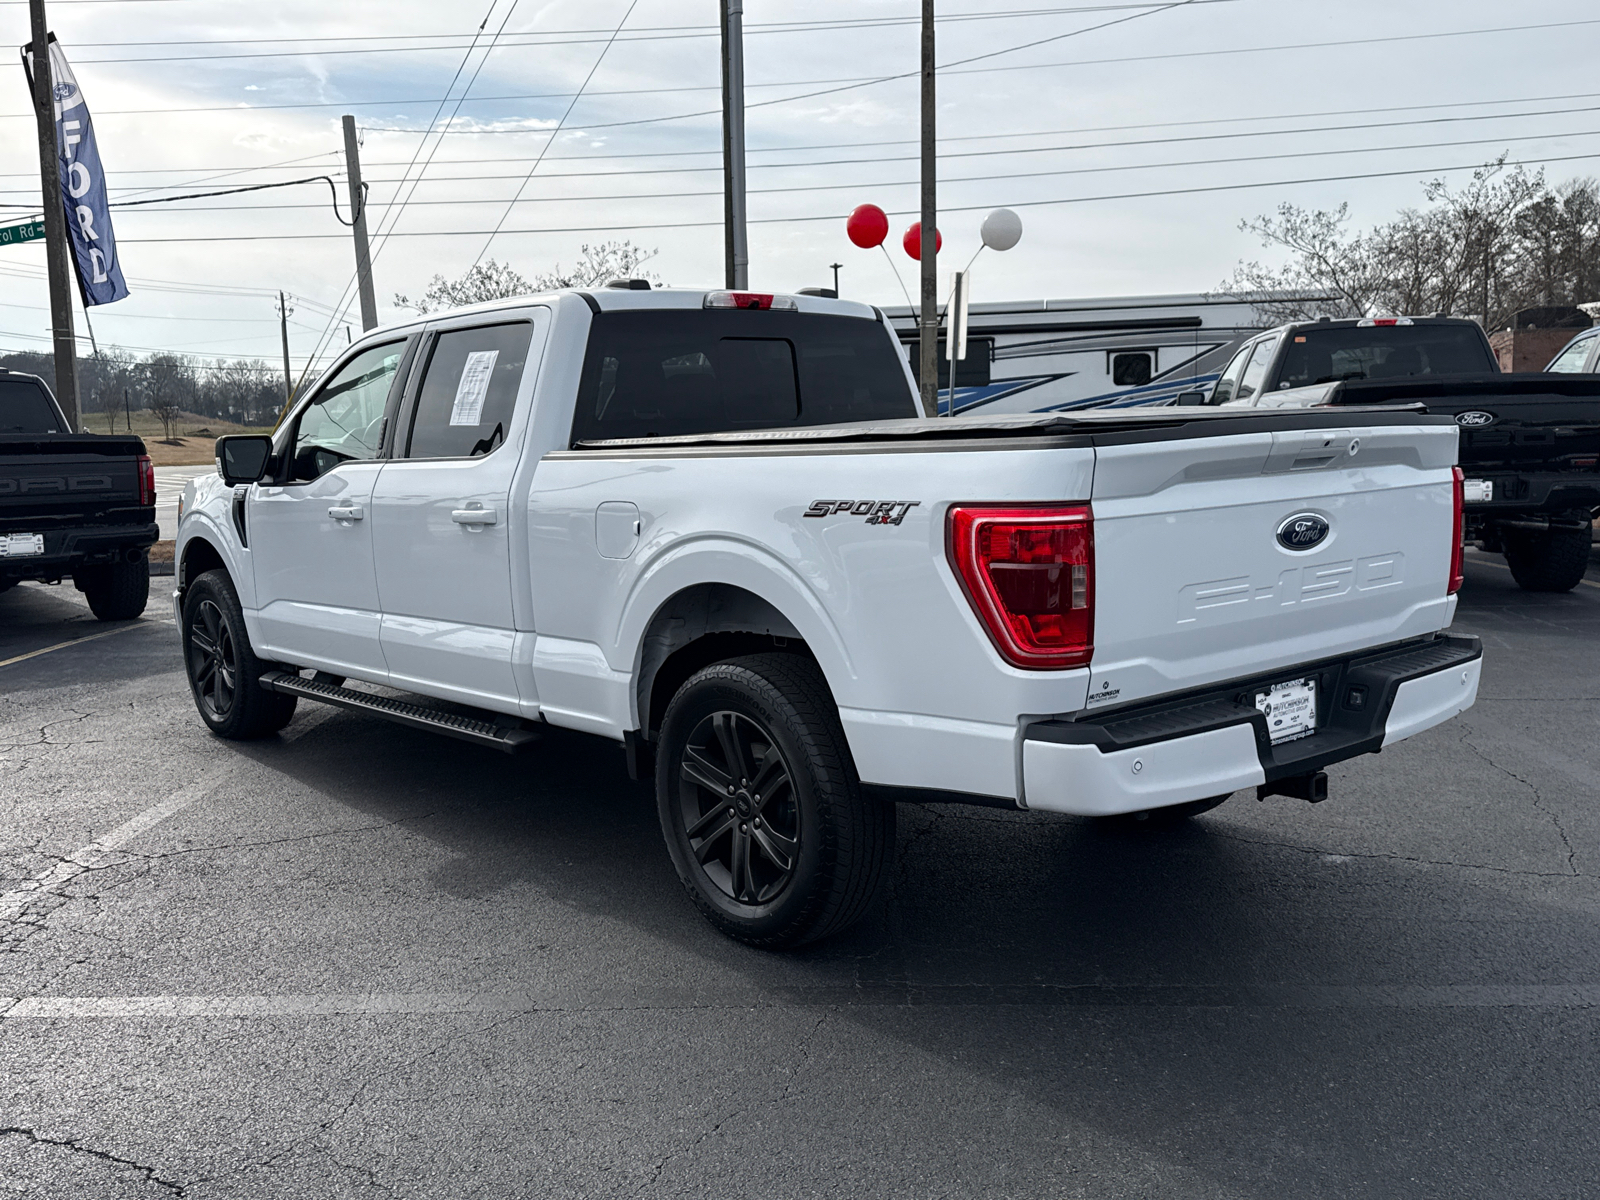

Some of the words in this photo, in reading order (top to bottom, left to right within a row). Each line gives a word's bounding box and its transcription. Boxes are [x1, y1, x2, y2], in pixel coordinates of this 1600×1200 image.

[62, 119, 108, 284] FORD
[19, 225, 35, 239] Rd
[1461, 414, 1487, 424] Ford
[802, 499, 922, 518] SPORT
[1292, 521, 1321, 542] Ford
[1176, 551, 1405, 624] F-150
[1088, 689, 1121, 700] HUTCHINSON
[1273, 695, 1310, 712] HUTCHINSON
